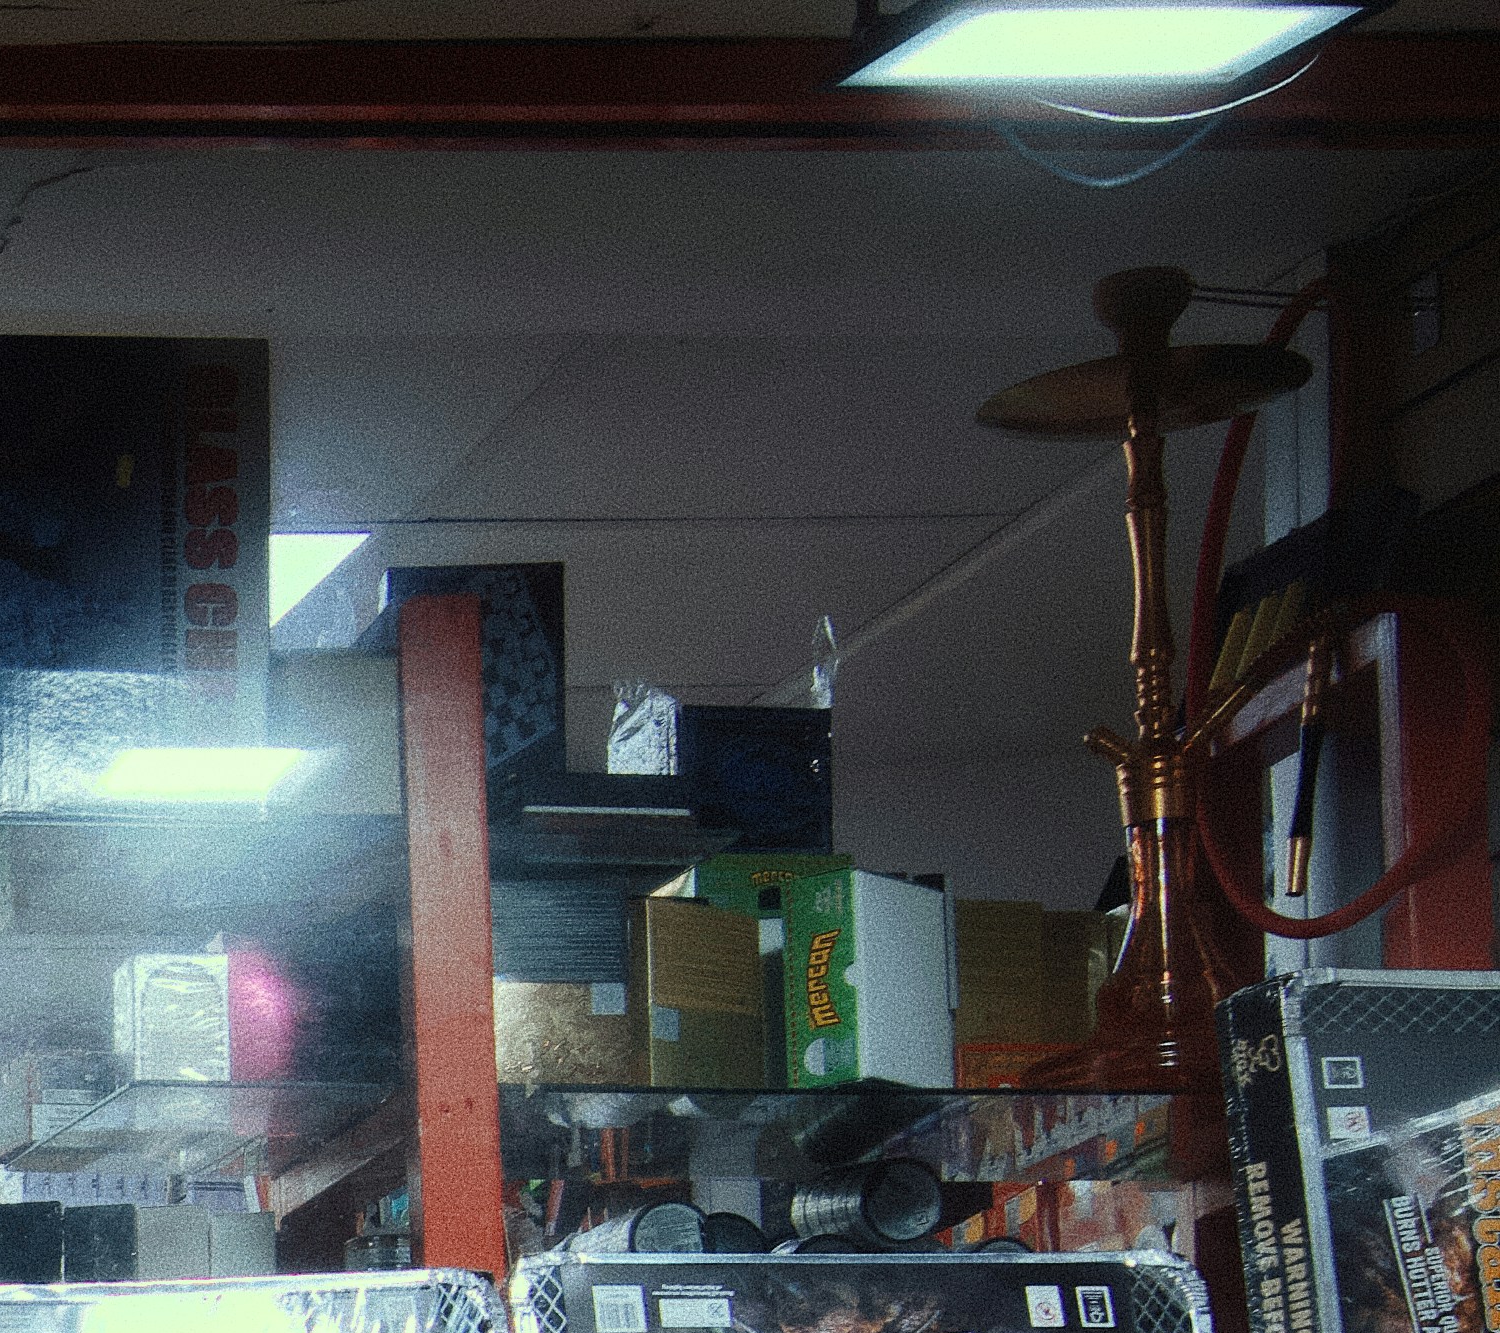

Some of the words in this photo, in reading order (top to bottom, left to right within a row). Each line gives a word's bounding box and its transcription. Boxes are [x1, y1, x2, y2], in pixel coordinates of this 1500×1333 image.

[184, 365, 239, 569] GLASS
[1243, 1160, 1274, 1271] REMOVE
[1389, 1194, 1424, 1254] BURNS
[1401, 1259, 1439, 1321] HOTTER
